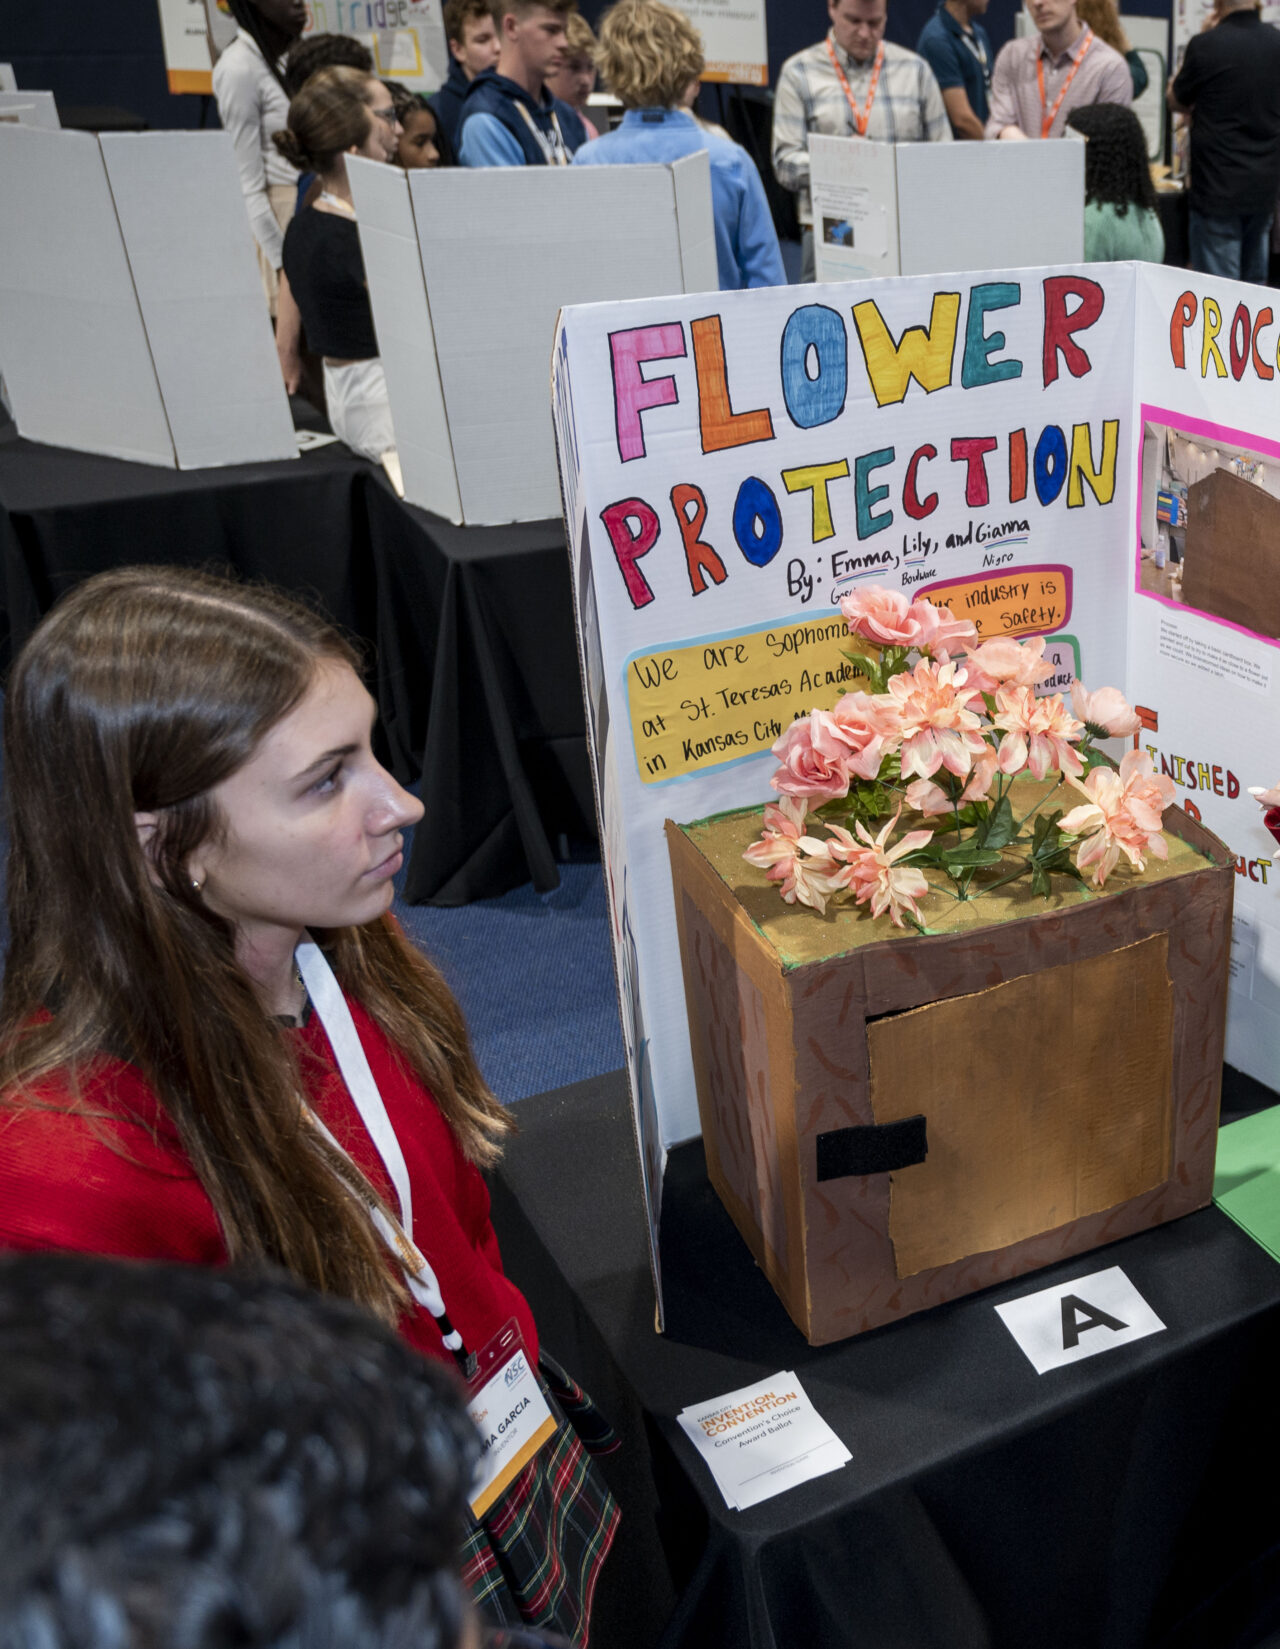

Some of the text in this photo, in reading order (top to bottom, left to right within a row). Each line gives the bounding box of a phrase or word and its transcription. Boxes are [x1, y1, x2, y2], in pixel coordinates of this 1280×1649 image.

[607, 275, 1105, 463] FLOWER
[600, 419, 1120, 609] PROTECTION
[787, 518, 1031, 604] By: Emma, Lily, and Gianna
[965, 582, 1030, 609] industry
[1041, 581, 1056, 595] is
[633, 657, 679, 689] We
[703, 644, 749, 670] are
[641, 661, 871, 738] at St. Teresas Academ
[643, 718, 783, 775] in Kansas City
[1058, 1294, 1131, 1351] A
[497, 1396, 531, 1435] GARCIA
[714, 1406, 801, 1448] Convention's Choice
[739, 1420, 793, 1448] Award Ballot
